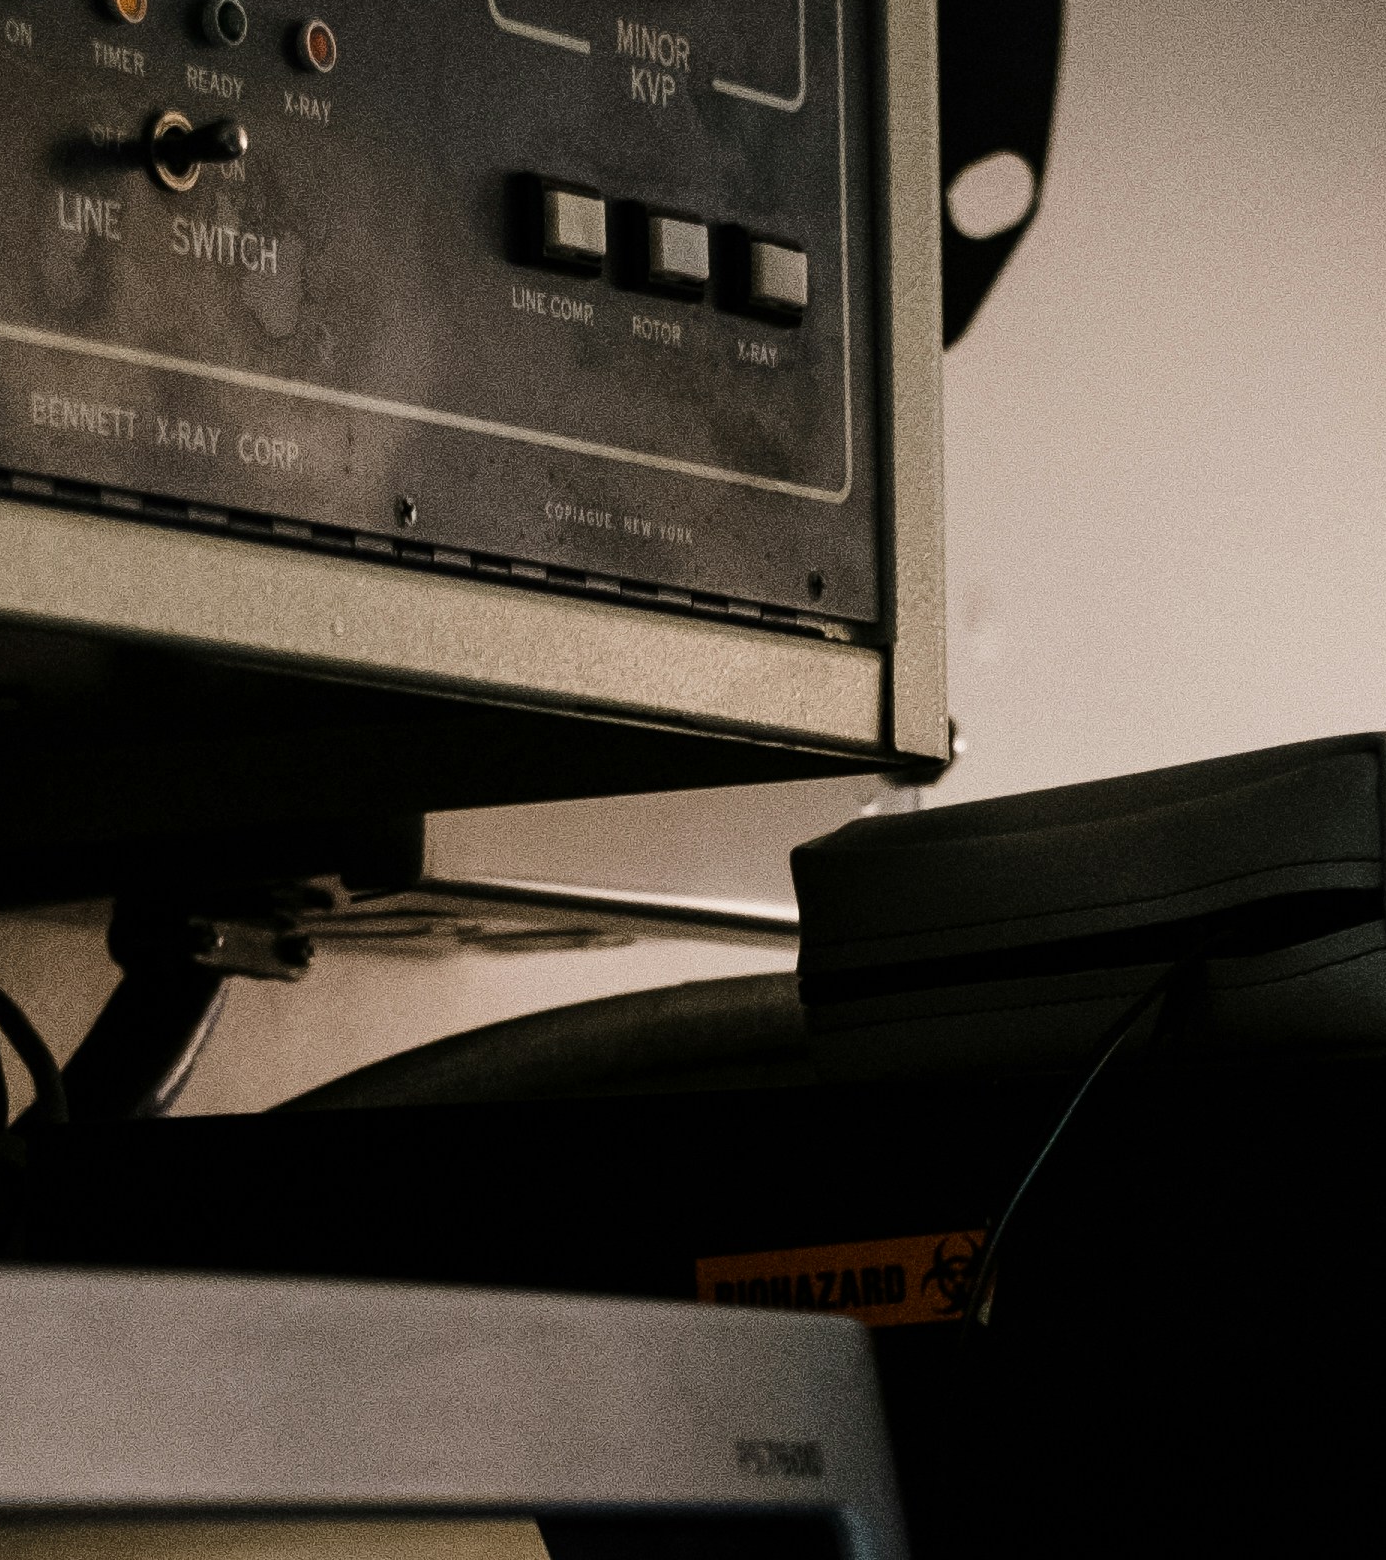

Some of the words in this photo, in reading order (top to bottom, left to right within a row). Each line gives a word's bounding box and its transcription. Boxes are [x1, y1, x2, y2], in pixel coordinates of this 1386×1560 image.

[4, 16, 34, 48] ON
[616, 15, 692, 74] MINOR
[93, 40, 147, 78] TIMER
[186, 64, 245, 102] READY
[630, 65, 677, 109] KVP
[283, 90, 333, 126] X-RAY
[58, 189, 123, 243] LINE
[171, 216, 279, 276] SWITCH
[511, 286, 547, 317] LINE
[631, 314, 683, 348] ROTOR
[30, 390, 137, 441] BENNETT
[155, 415, 223, 457] X-RAY
[622, 514, 653, 539] NEW
[660, 523, 694, 545] YORK
[714, 1263, 906, 1310] BIOHAZARD
